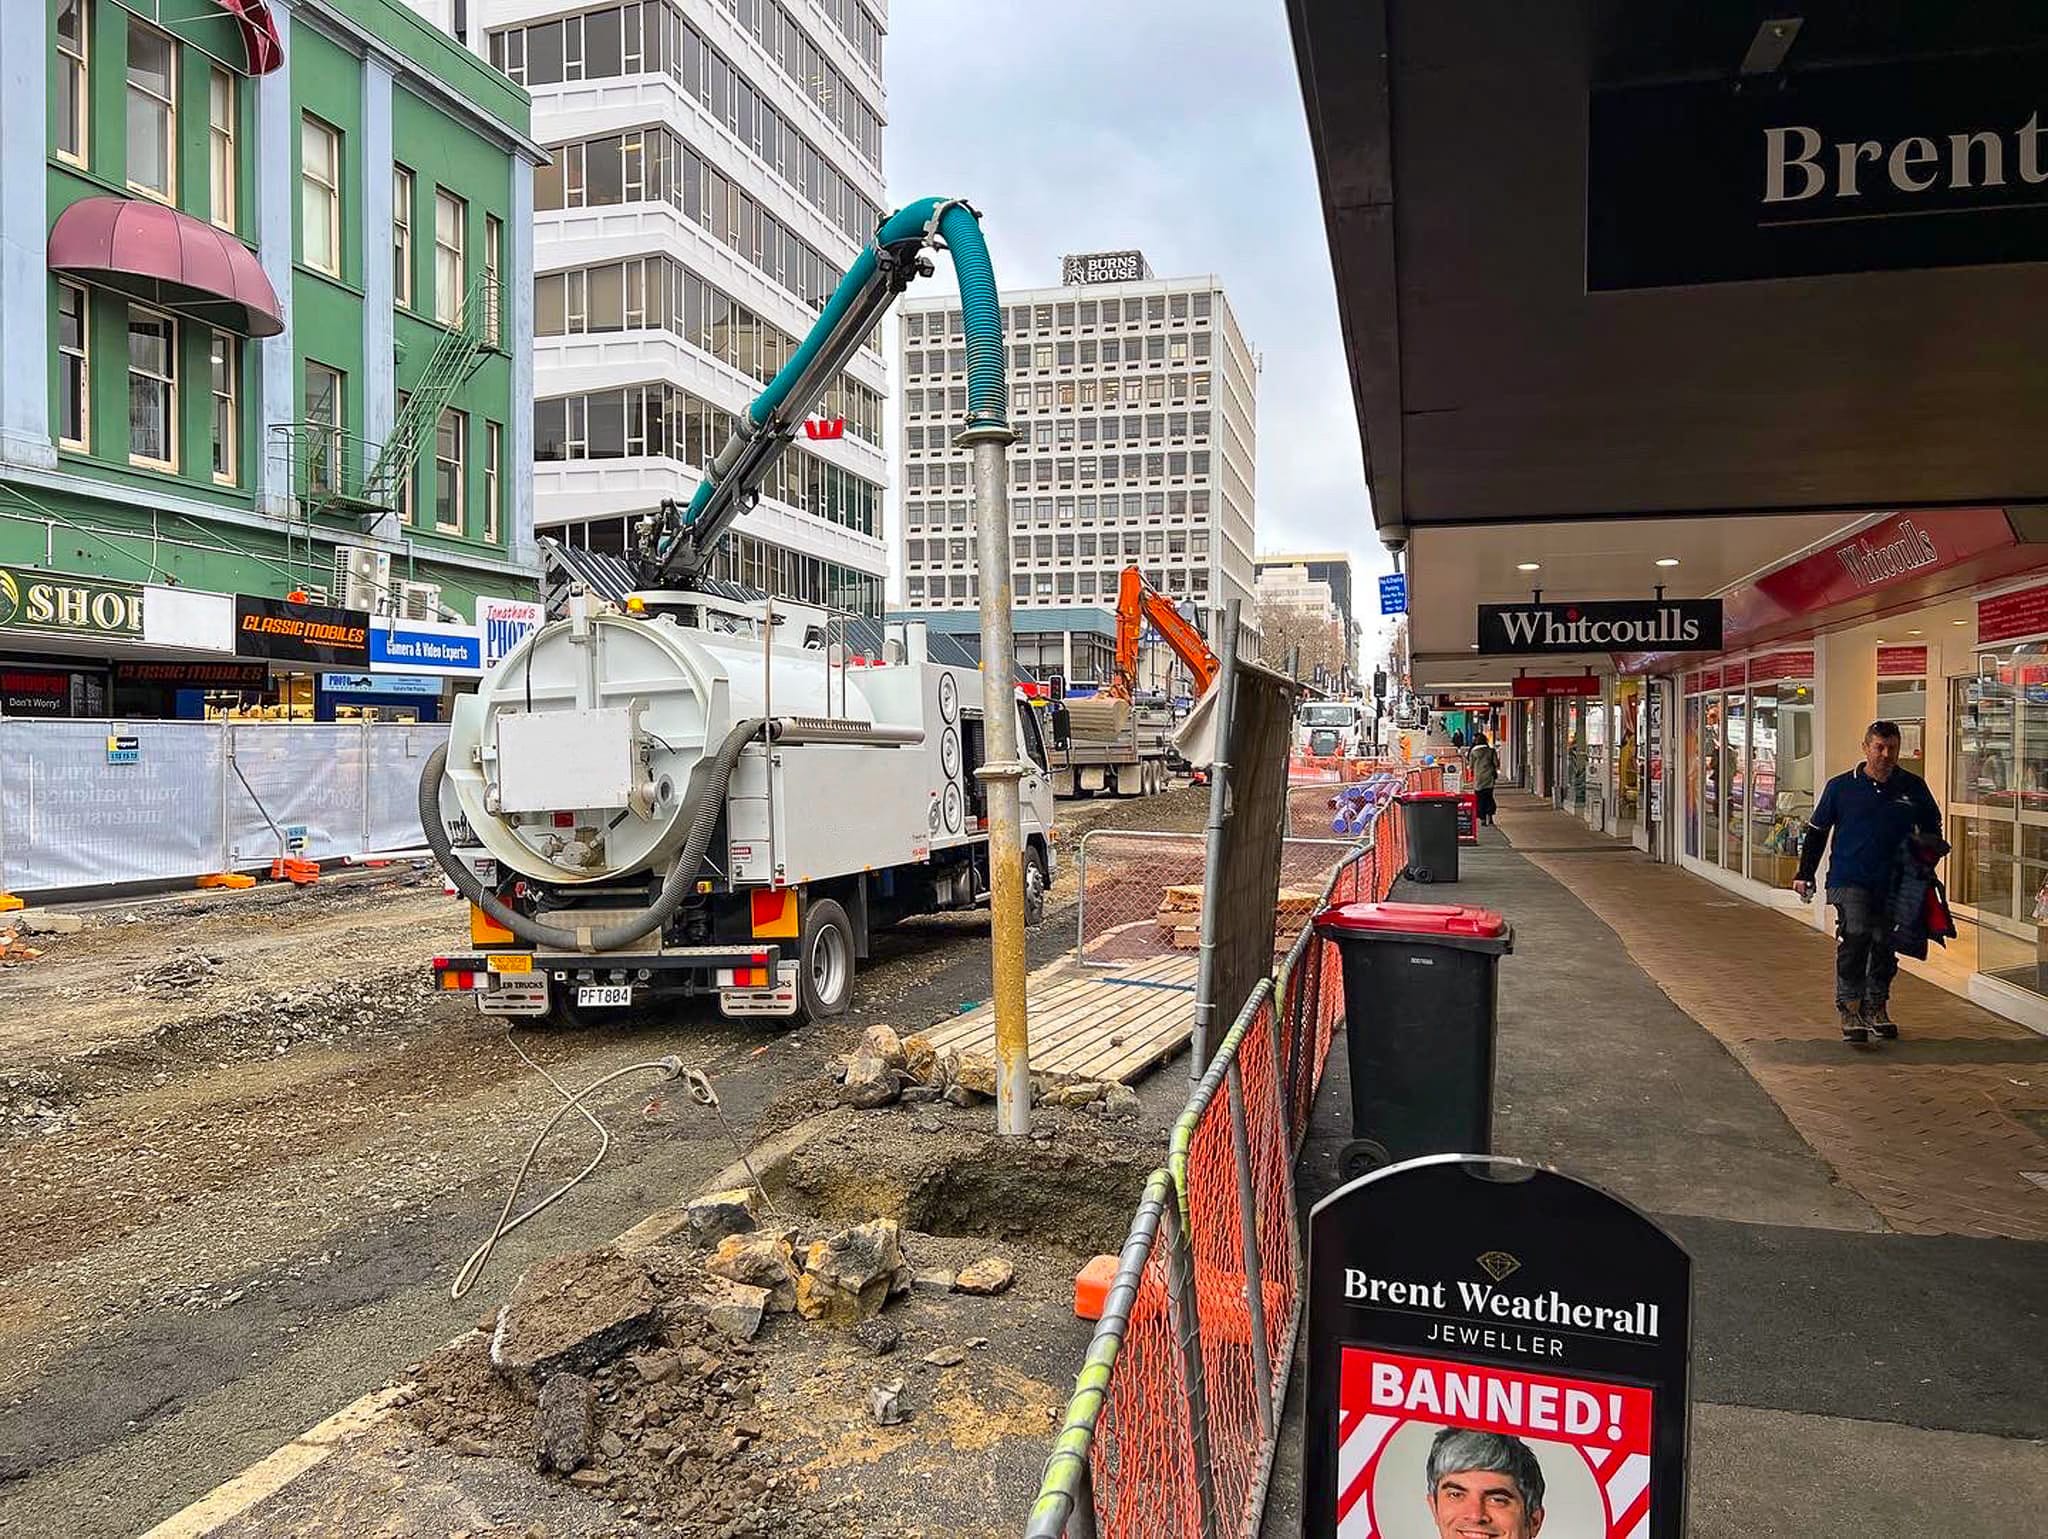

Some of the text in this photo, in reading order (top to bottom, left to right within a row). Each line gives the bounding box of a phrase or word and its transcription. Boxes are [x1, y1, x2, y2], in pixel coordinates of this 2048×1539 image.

[1762, 110, 2048, 203] Brent
[1087, 268, 1137, 282] HOUSE
[1088, 256, 1137, 271] BURNS
[1836, 519, 1938, 589] Whitcoulls
[242, 615, 365, 643] CLASSIC MOBILES
[487, 618, 535, 658] PHOT
[1498, 607, 1699, 645] Whitcoulls
[386, 640, 468, 661] Camera & Video Experts
[514, 981, 544, 989] TRUCKS
[580, 989, 628, 1003] PFT804
[1344, 1268, 1660, 1338] Brent Weatherall
[1427, 1323, 1564, 1358] JEWELLER
[1371, 1361, 1623, 1442] BANNED!
